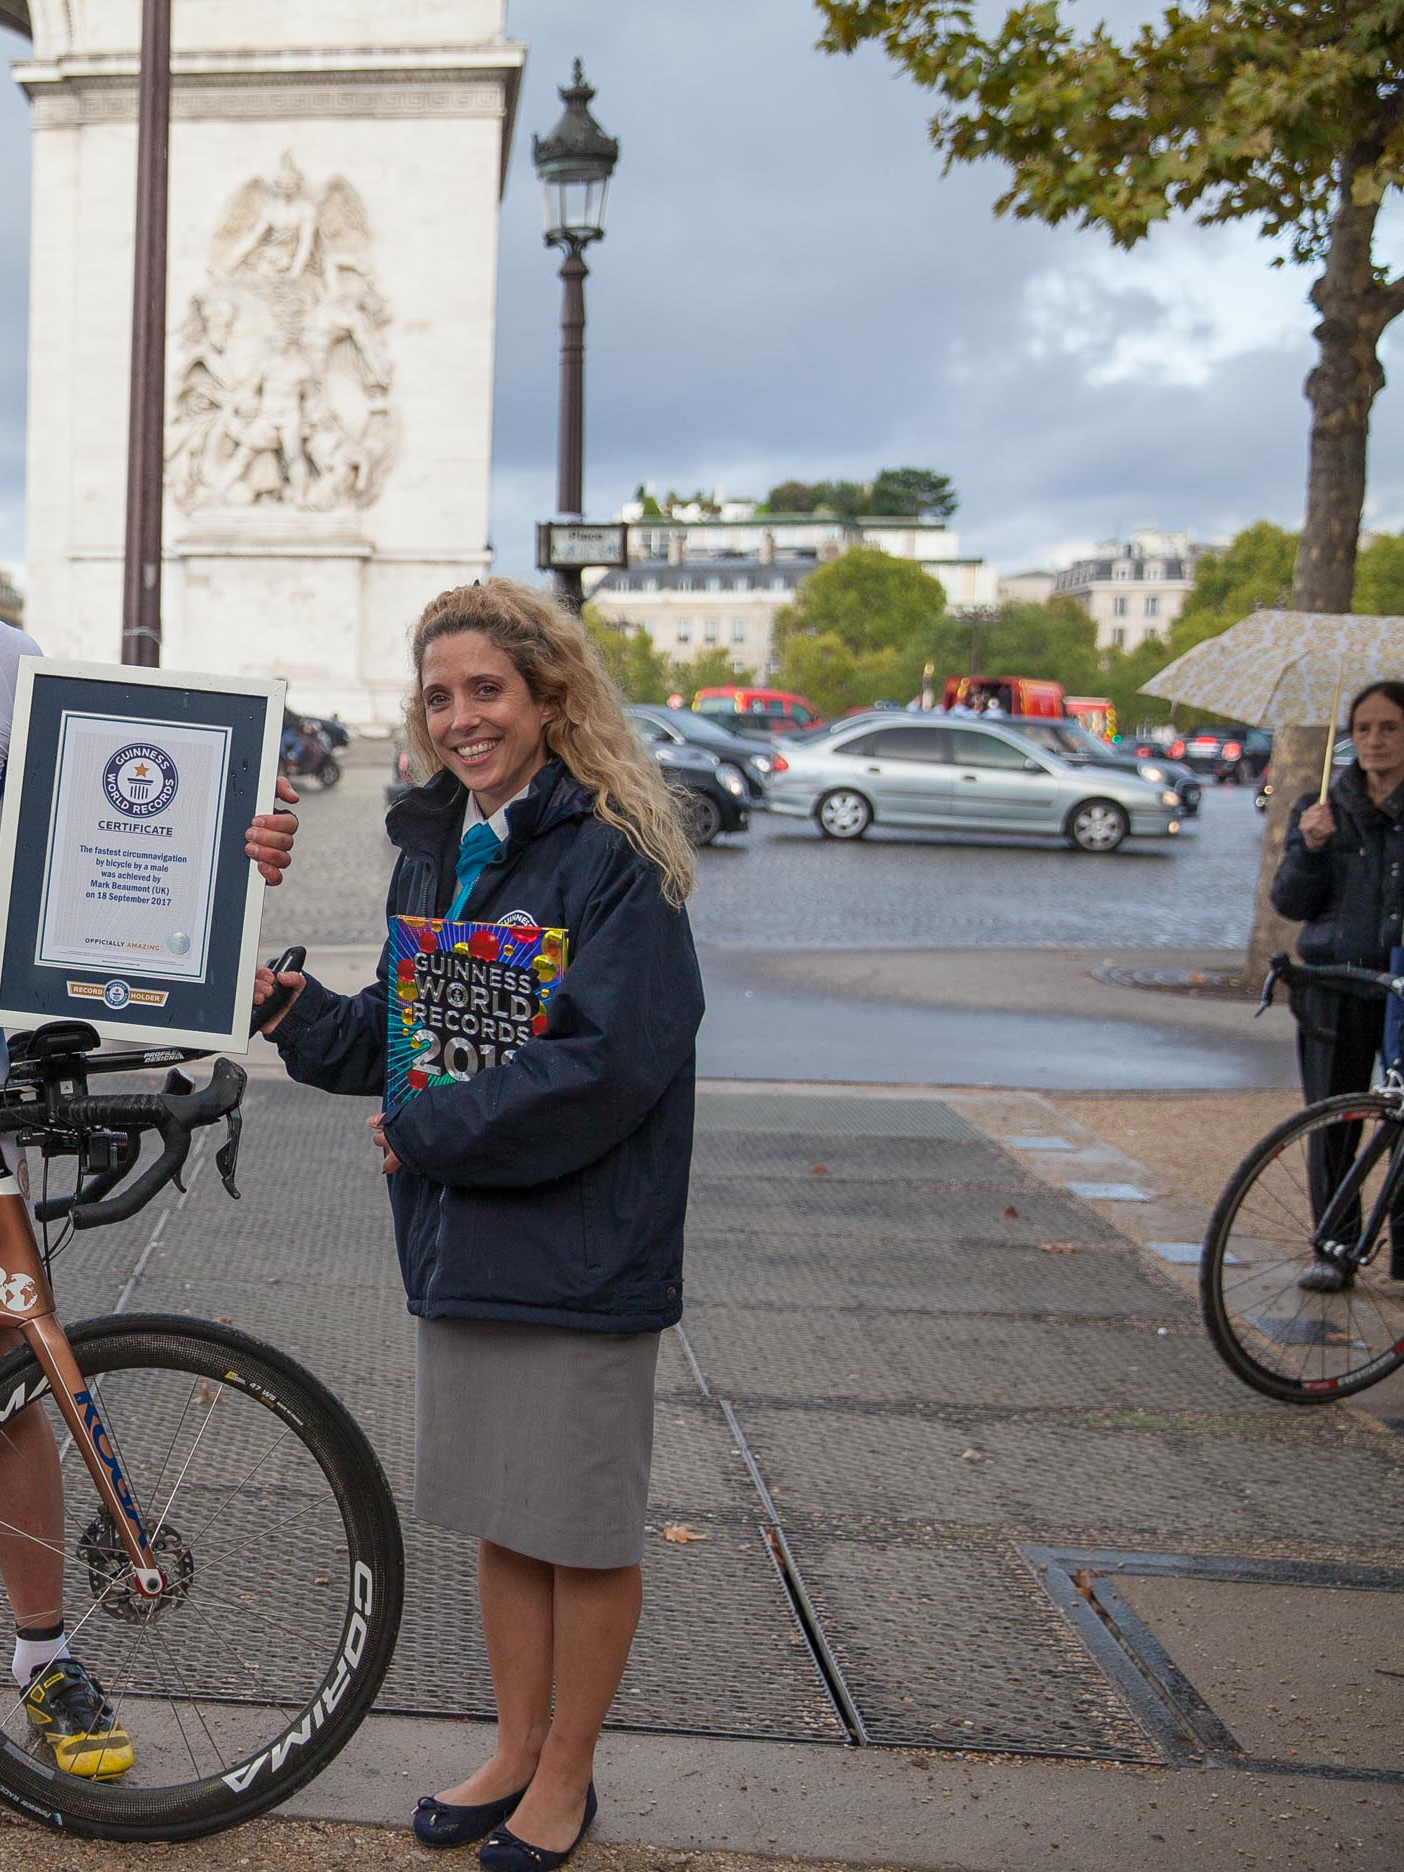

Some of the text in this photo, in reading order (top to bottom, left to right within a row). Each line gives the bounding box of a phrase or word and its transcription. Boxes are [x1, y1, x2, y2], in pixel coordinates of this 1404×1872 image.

[115, 748, 170, 770] GUINNESS
[107, 773, 174, 814] WORLD RECORDS
[98, 820, 173, 836] CERTIFICATE
[80, 845, 188, 863] The fastest circumnavigation
[95, 858, 105, 867] by
[106, 859, 132, 869] bicycle
[134, 862, 143, 872] by
[150, 864, 169, 873] male
[117, 872, 151, 882] achieved
[152, 875, 162, 884] by
[90, 880, 170, 896] Mark Beaumont (UK)
[97, 892, 107, 900] 18
[108, 893, 150, 904] September
[151, 897, 172, 906] 2017
[84, 938, 160, 951] OFFICIALLY AMAZING
[413, 952, 532, 995] GUINNESS
[73, 986, 160, 1002] RECORD HOLDER
[413, 973, 532, 1022] WORLD
[412, 1002, 531, 1046] RECORDS
[144, 1054, 175, 1063] DESIGN
[249, 1382, 261, 1391] 47
[74, 1390, 148, 1550] KOGA
[221, 1560, 373, 1795] CORIMA
